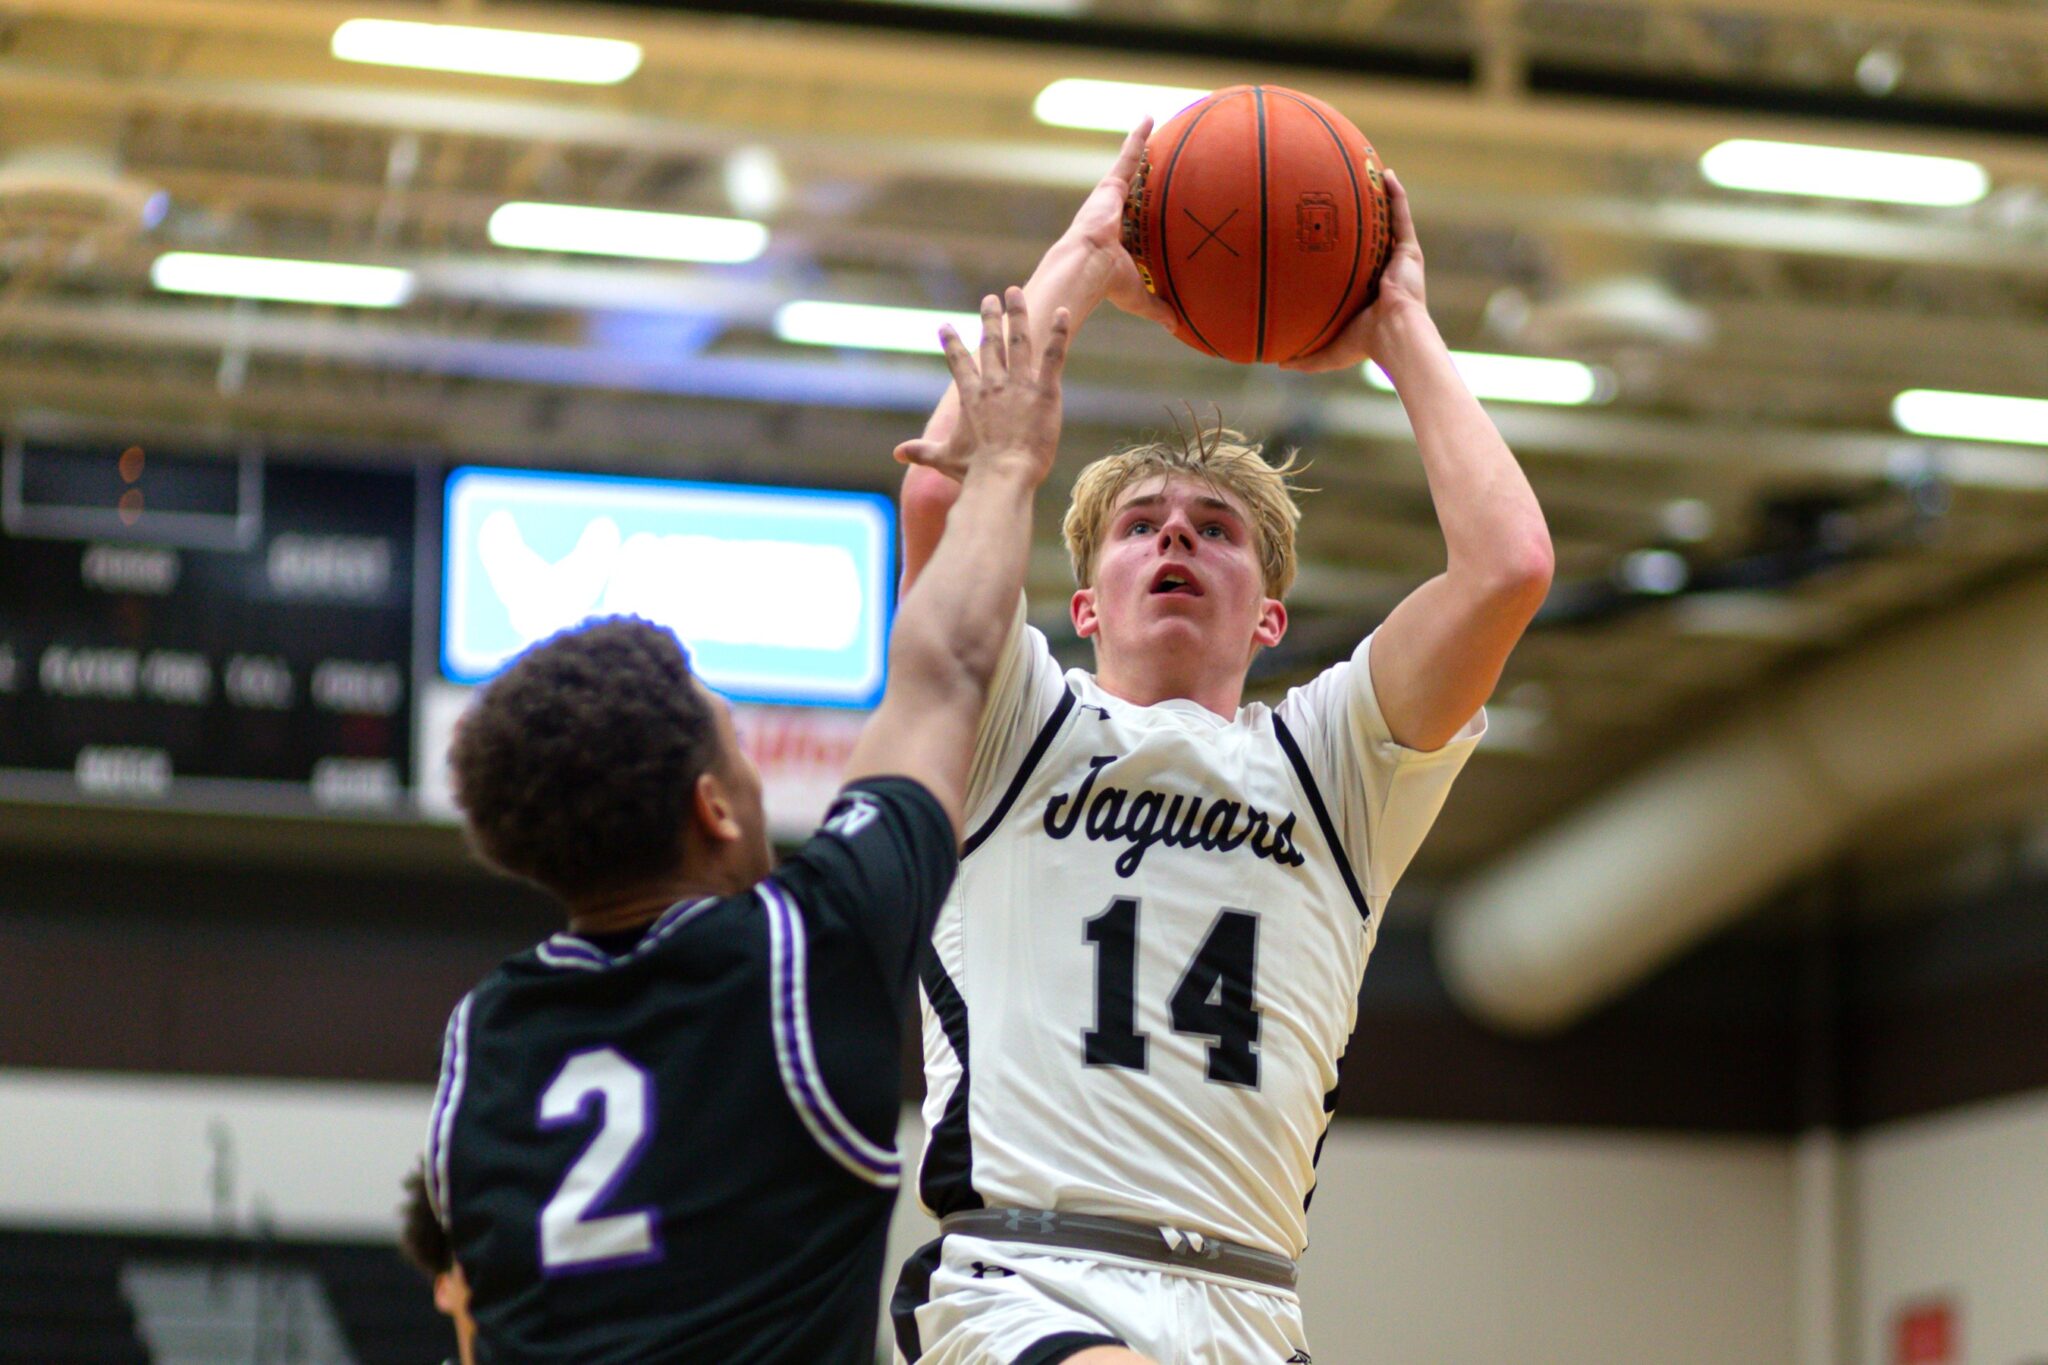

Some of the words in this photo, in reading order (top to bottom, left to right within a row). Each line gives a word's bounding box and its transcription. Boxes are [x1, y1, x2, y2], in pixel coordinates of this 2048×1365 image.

[1042, 754, 1306, 878] Jaguars
[1080, 894, 1263, 1092] 14
[537, 1044, 664, 1277] 2
